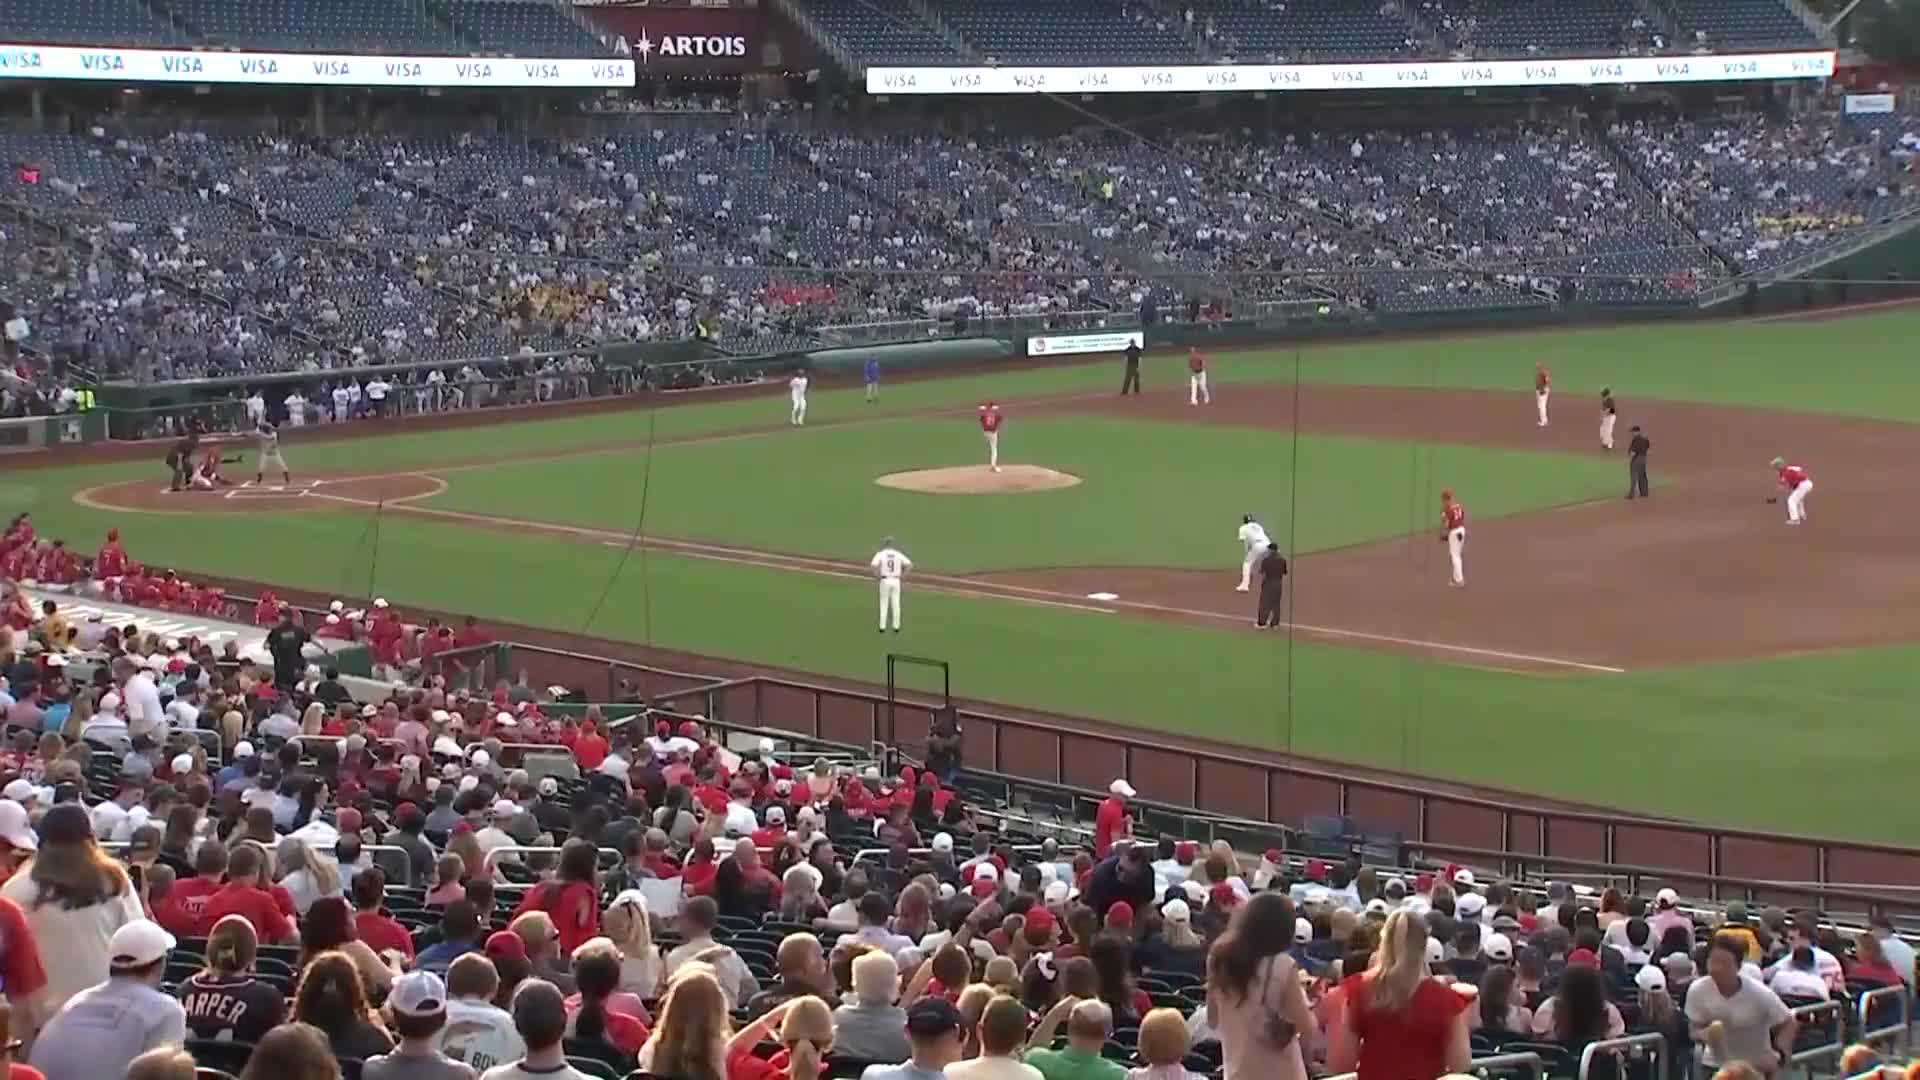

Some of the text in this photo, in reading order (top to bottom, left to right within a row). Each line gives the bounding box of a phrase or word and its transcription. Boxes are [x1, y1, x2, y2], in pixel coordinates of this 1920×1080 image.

[659, 35, 746, 56] ARTOIS
[0, 52, 625, 78] VISA VISA VISA VISA VISA VISA VISA VISA VISA
[884, 74, 916, 86] VISA
[950, 74, 981, 86] VISA
[1013, 74, 1045, 88] VISA
[1079, 73, 1108, 85] VISA
[1143, 72, 1173, 84] VISA
[1207, 71, 1236, 84] VISA
[1270, 71, 1299, 83] VISA
[1332, 71, 1363, 82] VISA
[1398, 69, 1428, 81] VISA
[1462, 68, 1492, 81] VISA
[1526, 66, 1557, 79] VISA
[1590, 65, 1622, 77] VISA
[1656, 63, 1689, 75] VISA
[1723, 62, 1757, 73] VISA
[887, 559, 895, 573] 9
[178, 992, 248, 1024] ARPER
